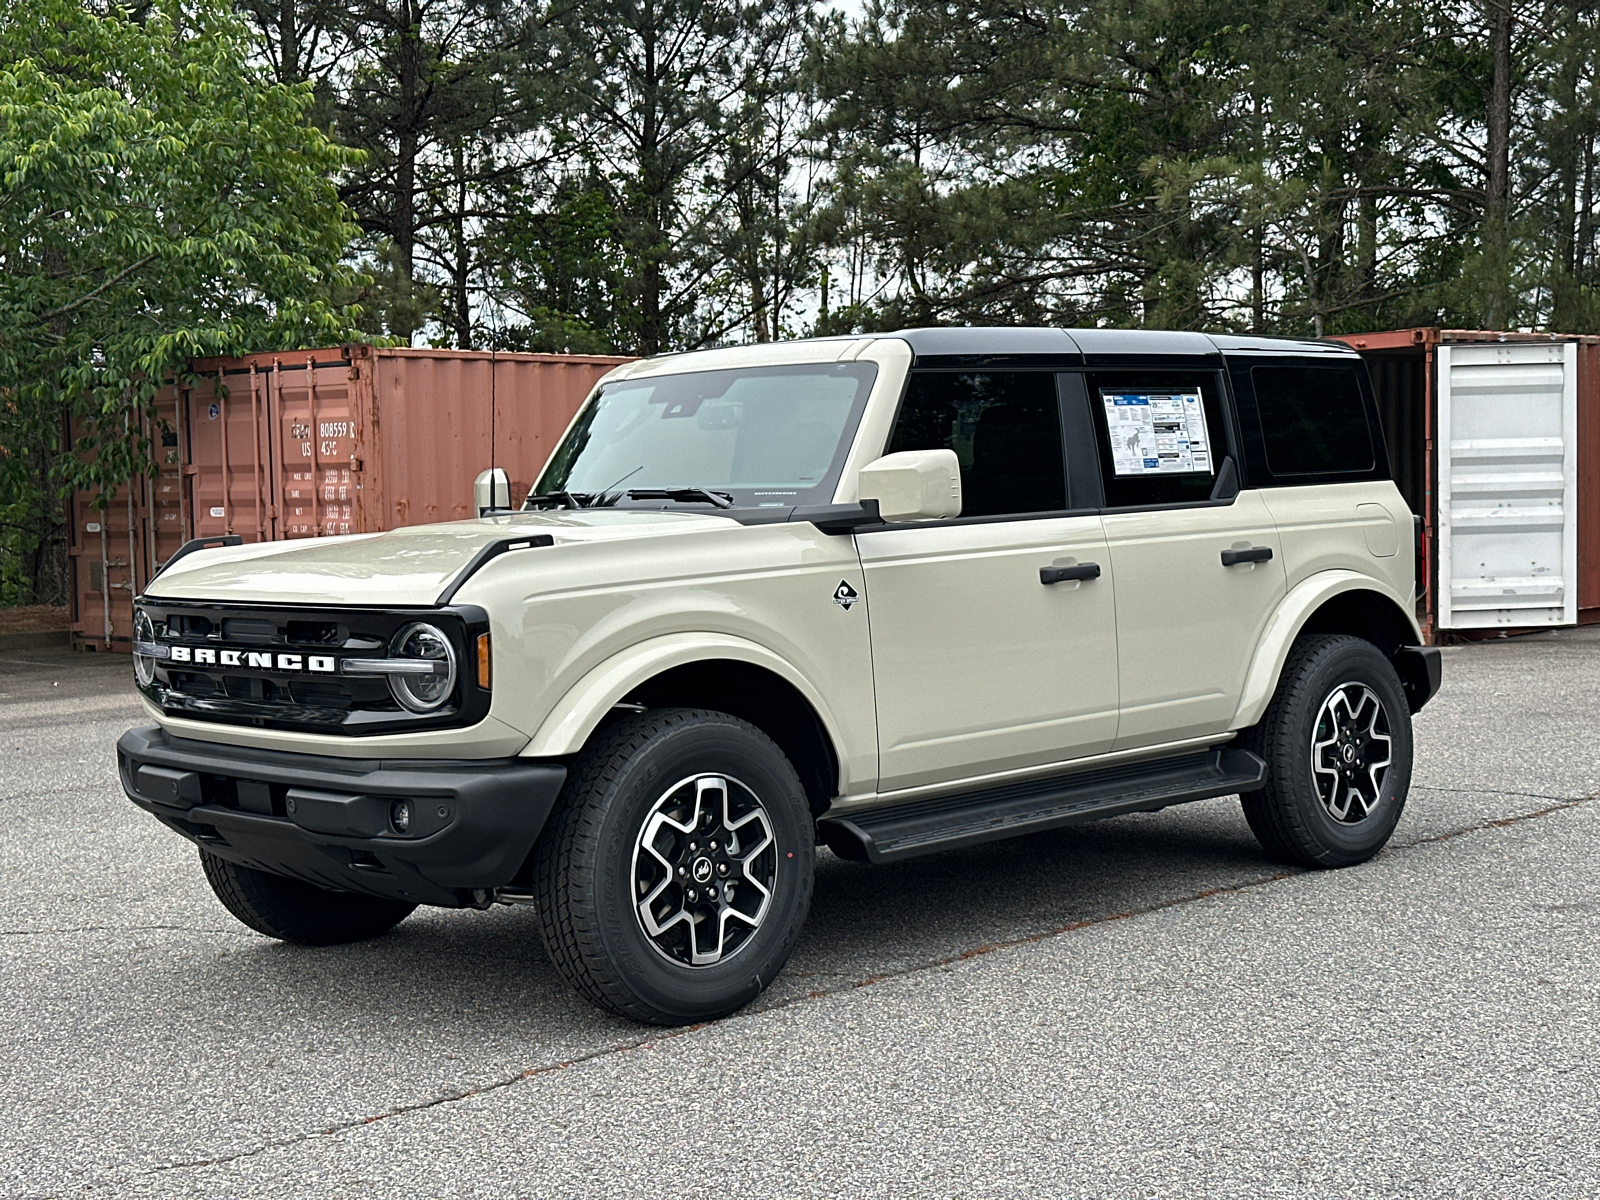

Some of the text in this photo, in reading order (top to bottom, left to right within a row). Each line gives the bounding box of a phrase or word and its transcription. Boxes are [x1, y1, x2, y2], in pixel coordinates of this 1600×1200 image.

[320, 422, 347, 438] 808559
[301, 441, 312, 457] US
[171, 646, 335, 672] BRONCO
[602, 760, 659, 975] BRIDGESTONE
